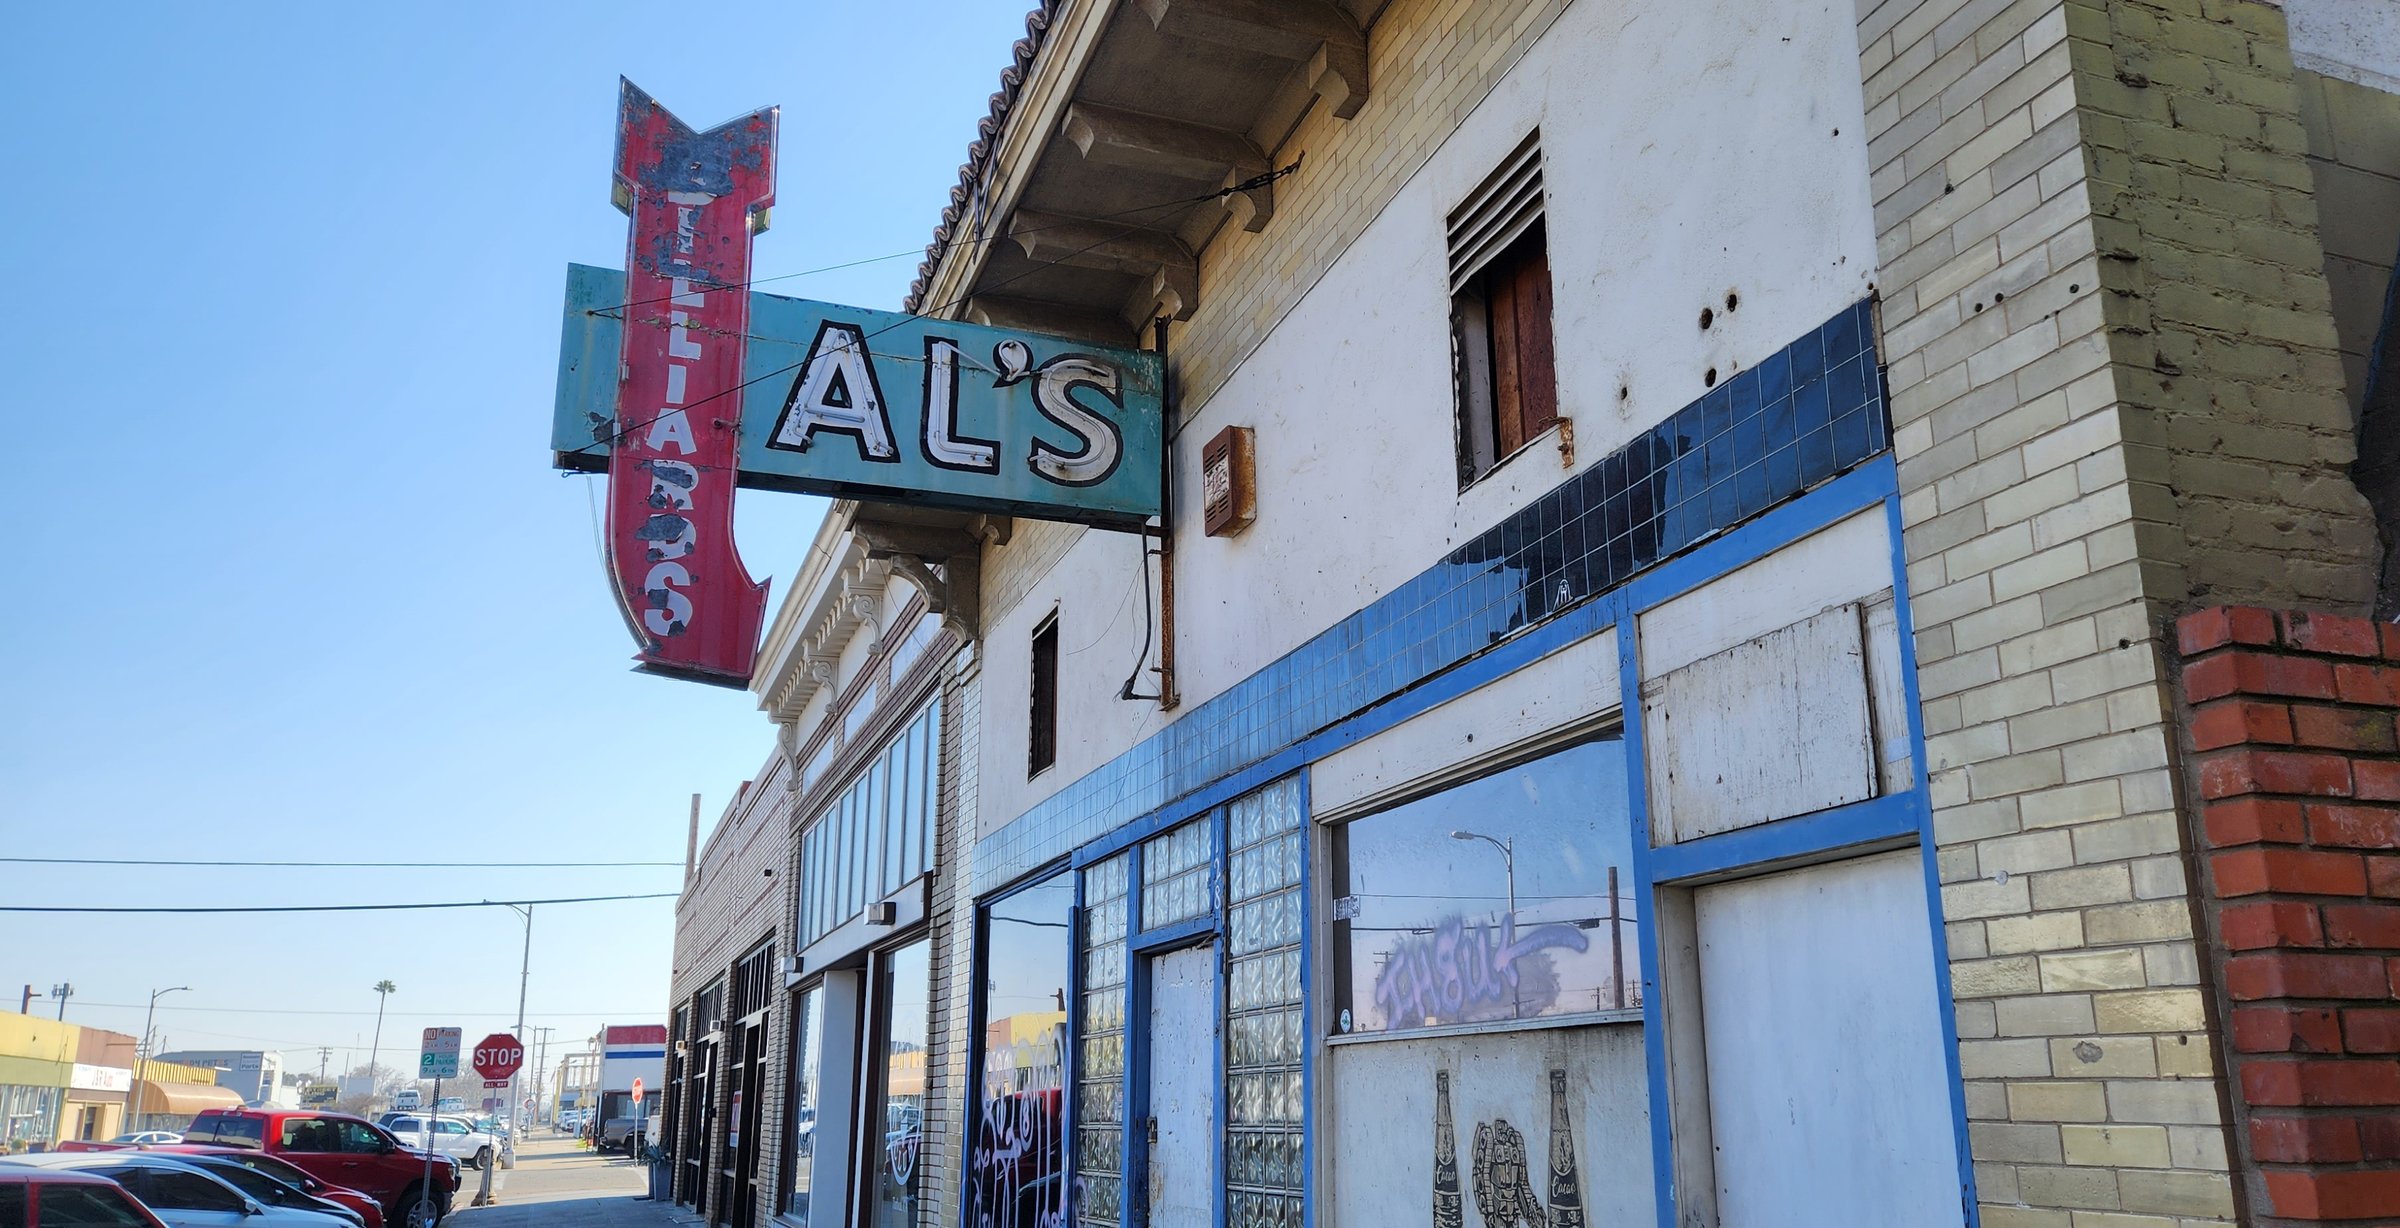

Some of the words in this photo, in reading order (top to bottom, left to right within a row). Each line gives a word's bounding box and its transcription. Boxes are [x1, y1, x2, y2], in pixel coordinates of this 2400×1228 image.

[767, 320, 1124, 488] AL'S
[644, 190, 717, 637] ILLIARDS
[425, 1028, 437, 1040] NO
[423, 1054, 432, 1065] 2
[475, 1048, 521, 1066] STOP
